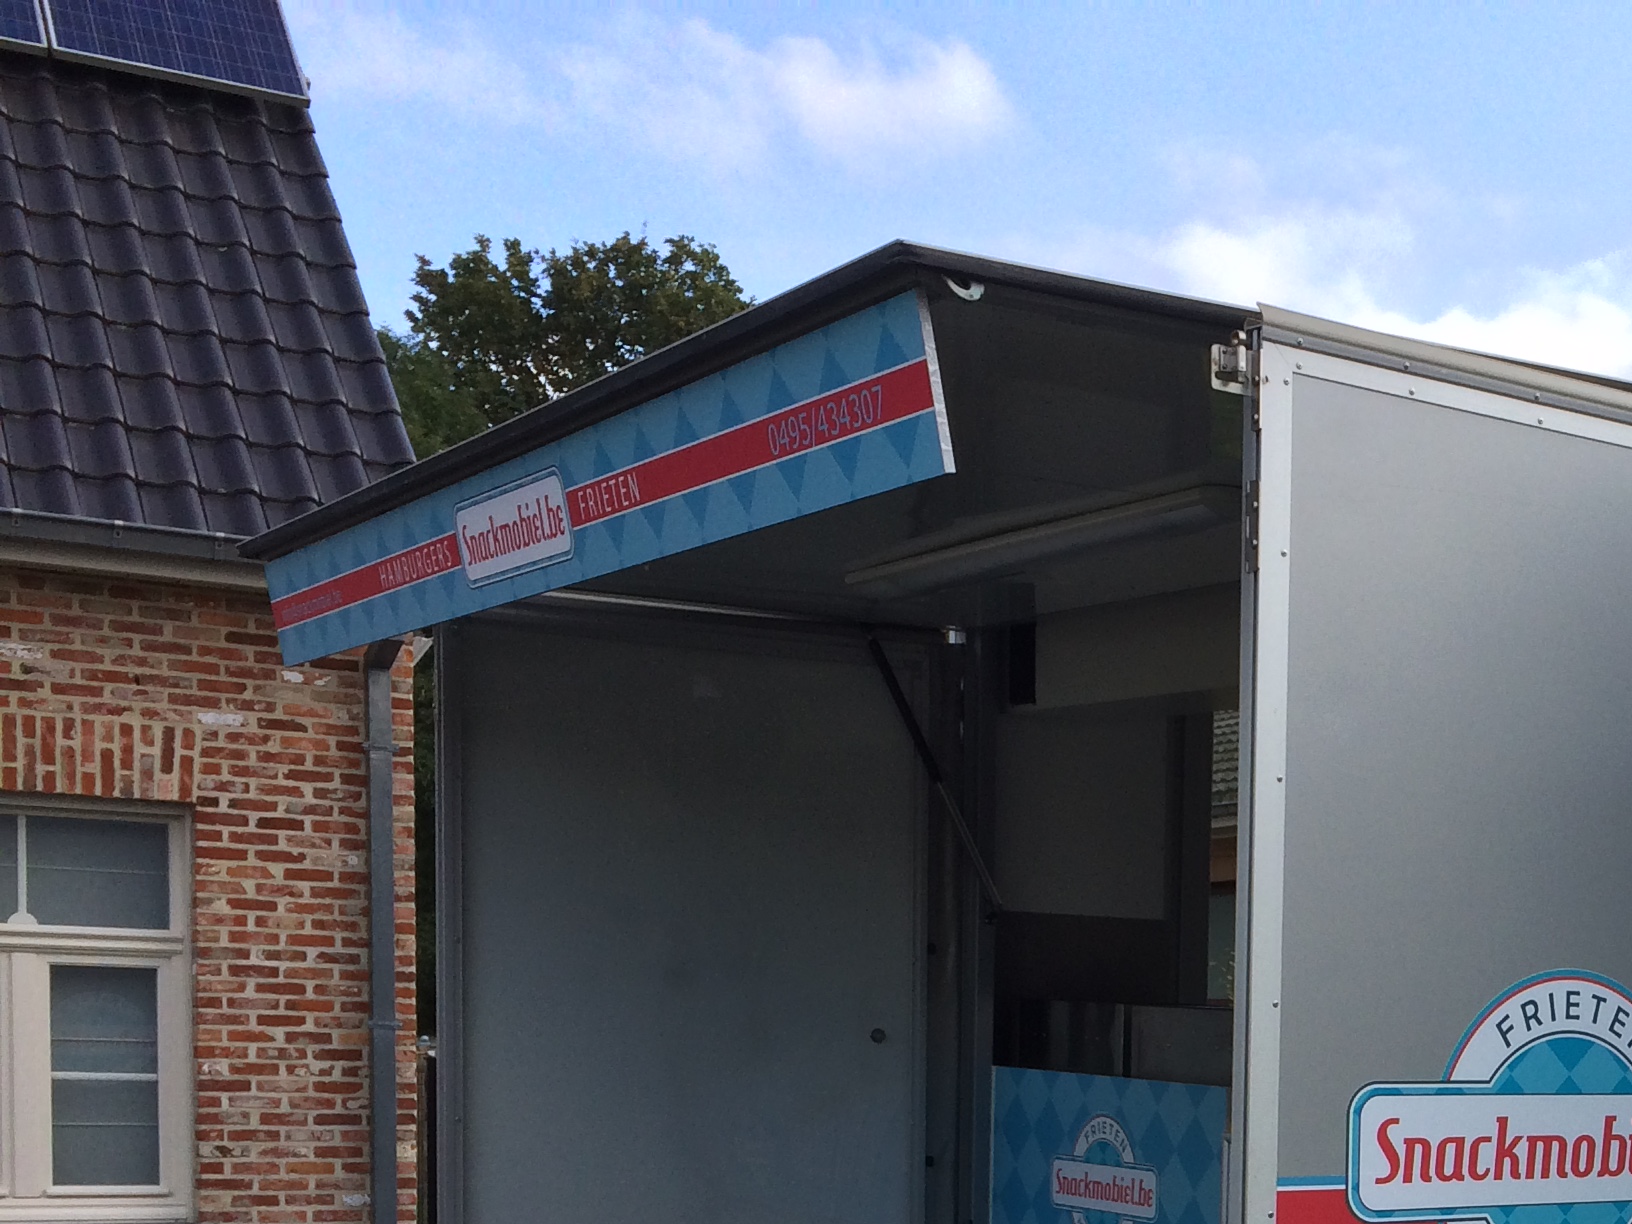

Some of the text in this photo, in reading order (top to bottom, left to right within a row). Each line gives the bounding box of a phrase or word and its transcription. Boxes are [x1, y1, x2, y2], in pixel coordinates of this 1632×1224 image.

[767, 384, 882, 456] 0495/434307
[577, 471, 641, 520] FRIETEN
[462, 494, 566, 567] Snackmobiel.be
[378, 540, 452, 589] HAMBURGERS
[1084, 1120, 1128, 1154] FRIETEN
[1055, 1168, 1154, 1208] Snackmobiel.be
